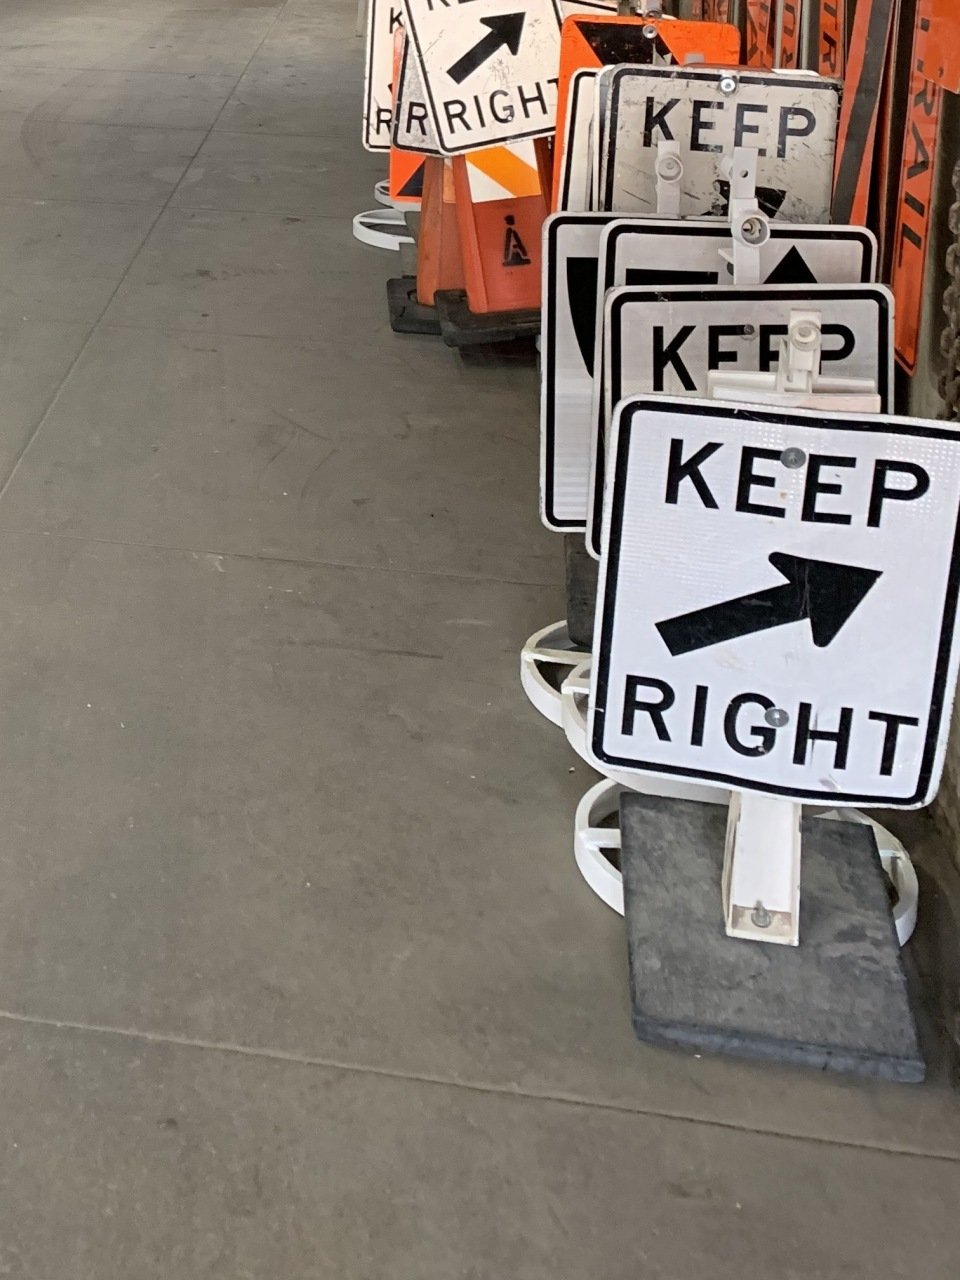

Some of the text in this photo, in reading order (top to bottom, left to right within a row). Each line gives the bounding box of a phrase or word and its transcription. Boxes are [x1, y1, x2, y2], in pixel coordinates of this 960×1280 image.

[643, 96, 817, 158] KEEP
[898, 17, 936, 268] RAIL
[664, 437, 930, 528] KEEP
[620, 674, 919, 777] RIGHT
